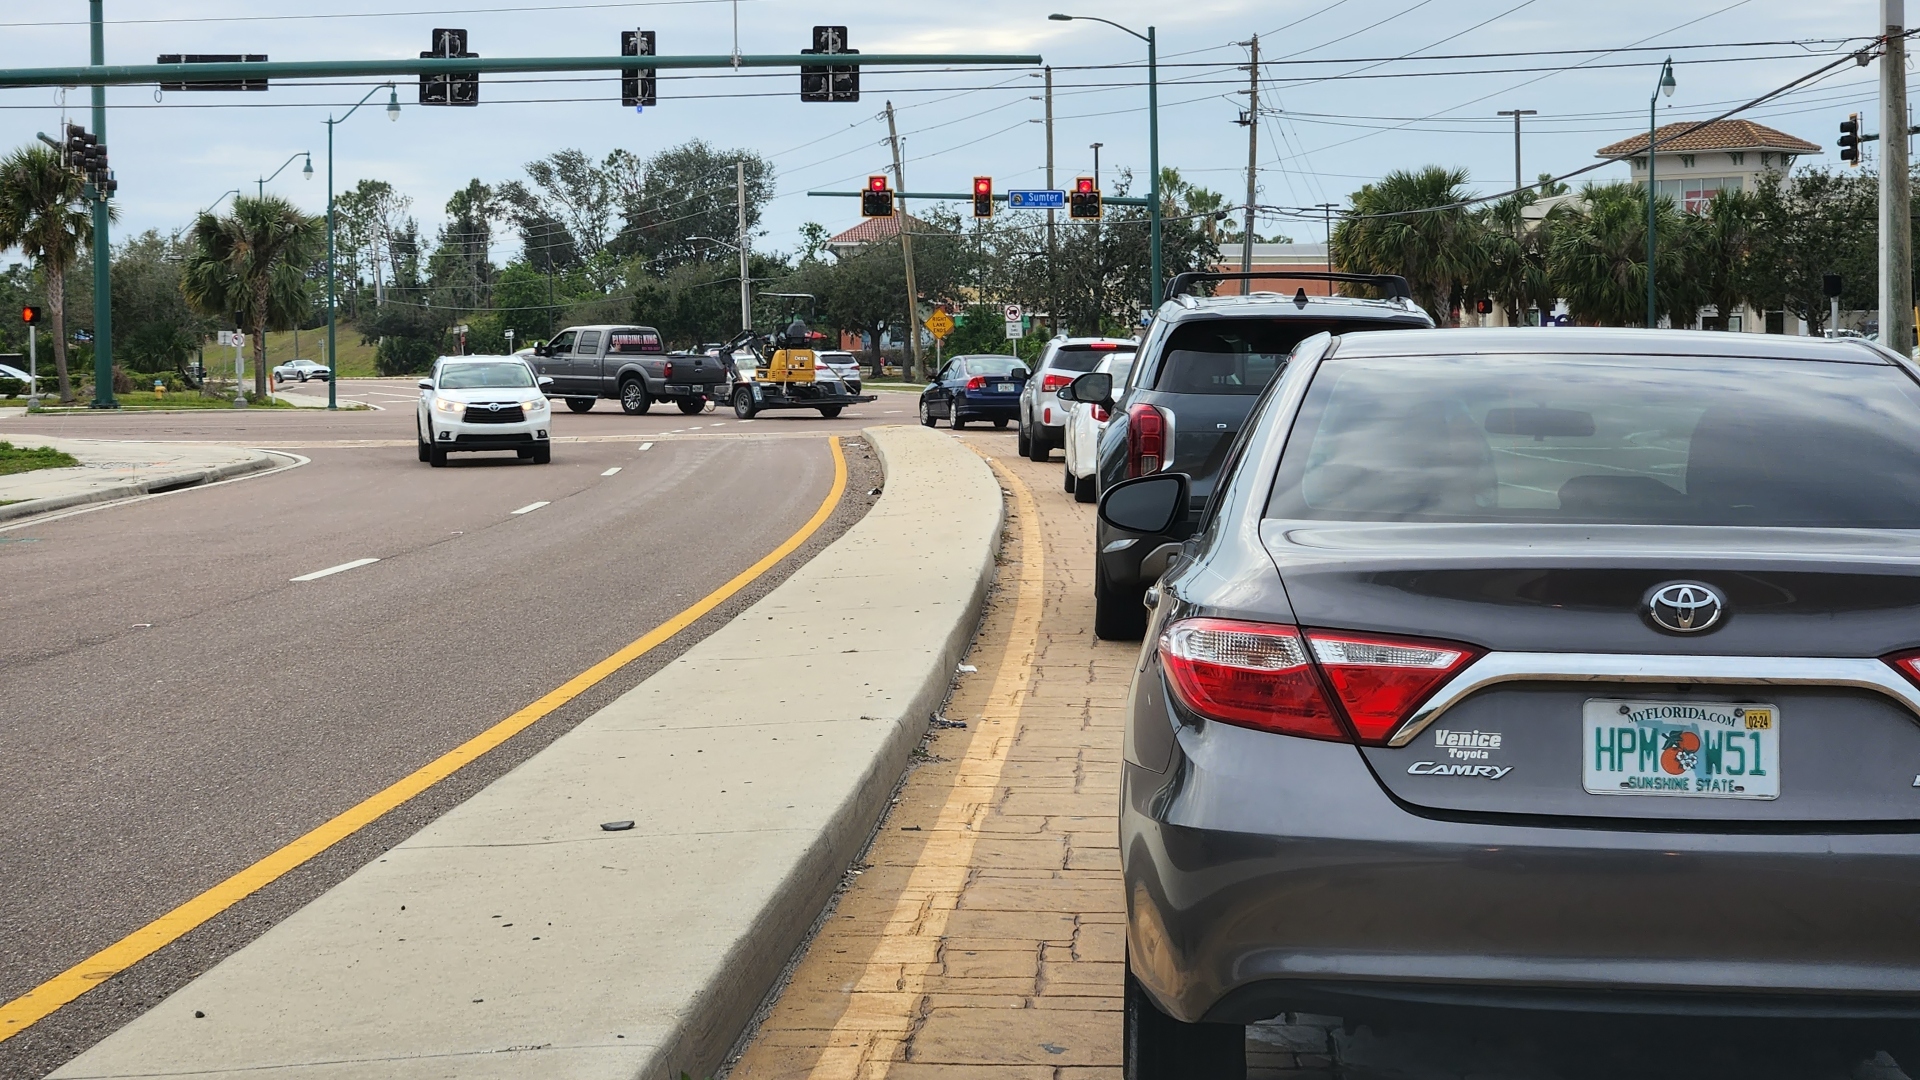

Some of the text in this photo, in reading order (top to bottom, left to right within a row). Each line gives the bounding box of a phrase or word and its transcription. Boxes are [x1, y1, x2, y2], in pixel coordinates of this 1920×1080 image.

[1028, 192, 1059, 202] Sumter
[611, 334, 643, 345] PLUMBING
[1627, 706, 1736, 727] MYFLORIDA.COM
[1748, 715, 1769, 728] 02-24
[1435, 729, 1502, 747] Venice
[1448, 748, 1489, 761] Toyota
[1595, 726, 1767, 777] HPM W51
[1407, 761, 1515, 780] CAMRY
[1628, 775, 1736, 793] SUNSHINE STATE
